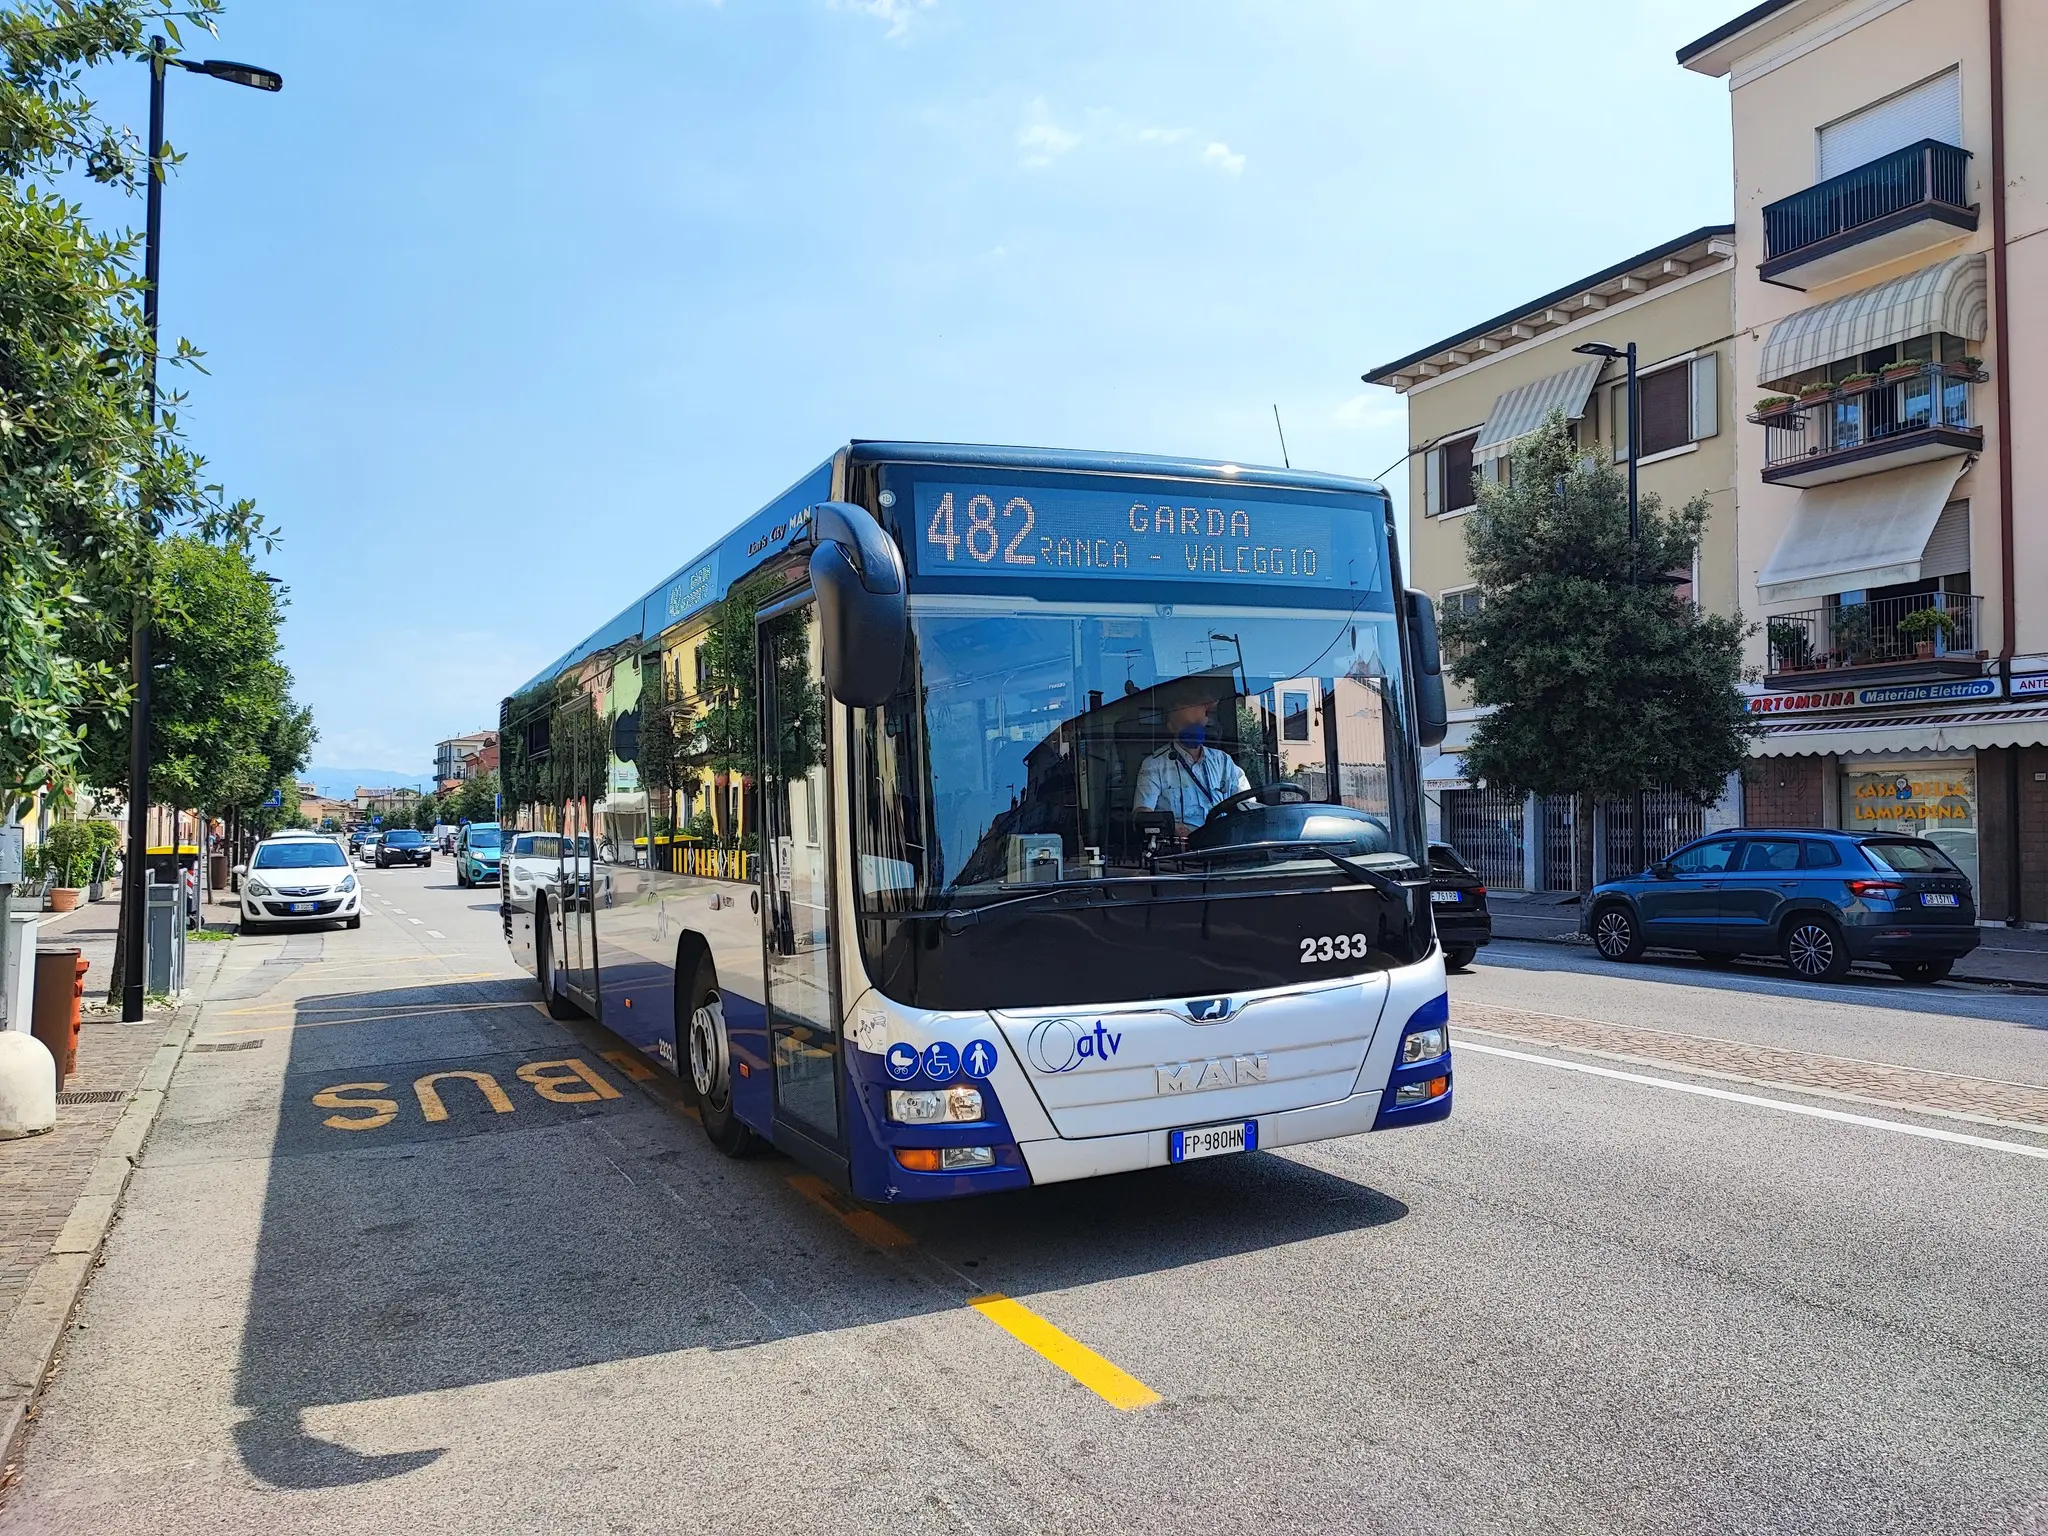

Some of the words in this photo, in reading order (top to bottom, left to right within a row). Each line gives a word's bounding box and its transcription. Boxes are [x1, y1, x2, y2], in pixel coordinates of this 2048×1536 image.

[747, 534, 768, 557] Lion's
[770, 523, 787, 543] City
[789, 504, 811, 531] MAN
[927, 491, 1037, 565] 482
[1128, 502, 1251, 538] GARDA
[1184, 543, 1317, 575] VALEGGIO
[1751, 691, 1855, 712] ORTOMBINA
[1865, 687, 1928, 703] Materiale
[1930, 683, 1989, 697] Elettrico
[2019, 678, 2048, 690] ANTE
[1855, 783, 1898, 798] CASA
[1911, 782, 1967, 797] DELLA
[1855, 804, 1968, 820] LAMPADINA
[1299, 933, 1368, 964] 2333
[1077, 1019, 1122, 1061] atv
[1156, 1052, 1269, 1096] MAN
[312, 1058, 623, 1131] BUS
